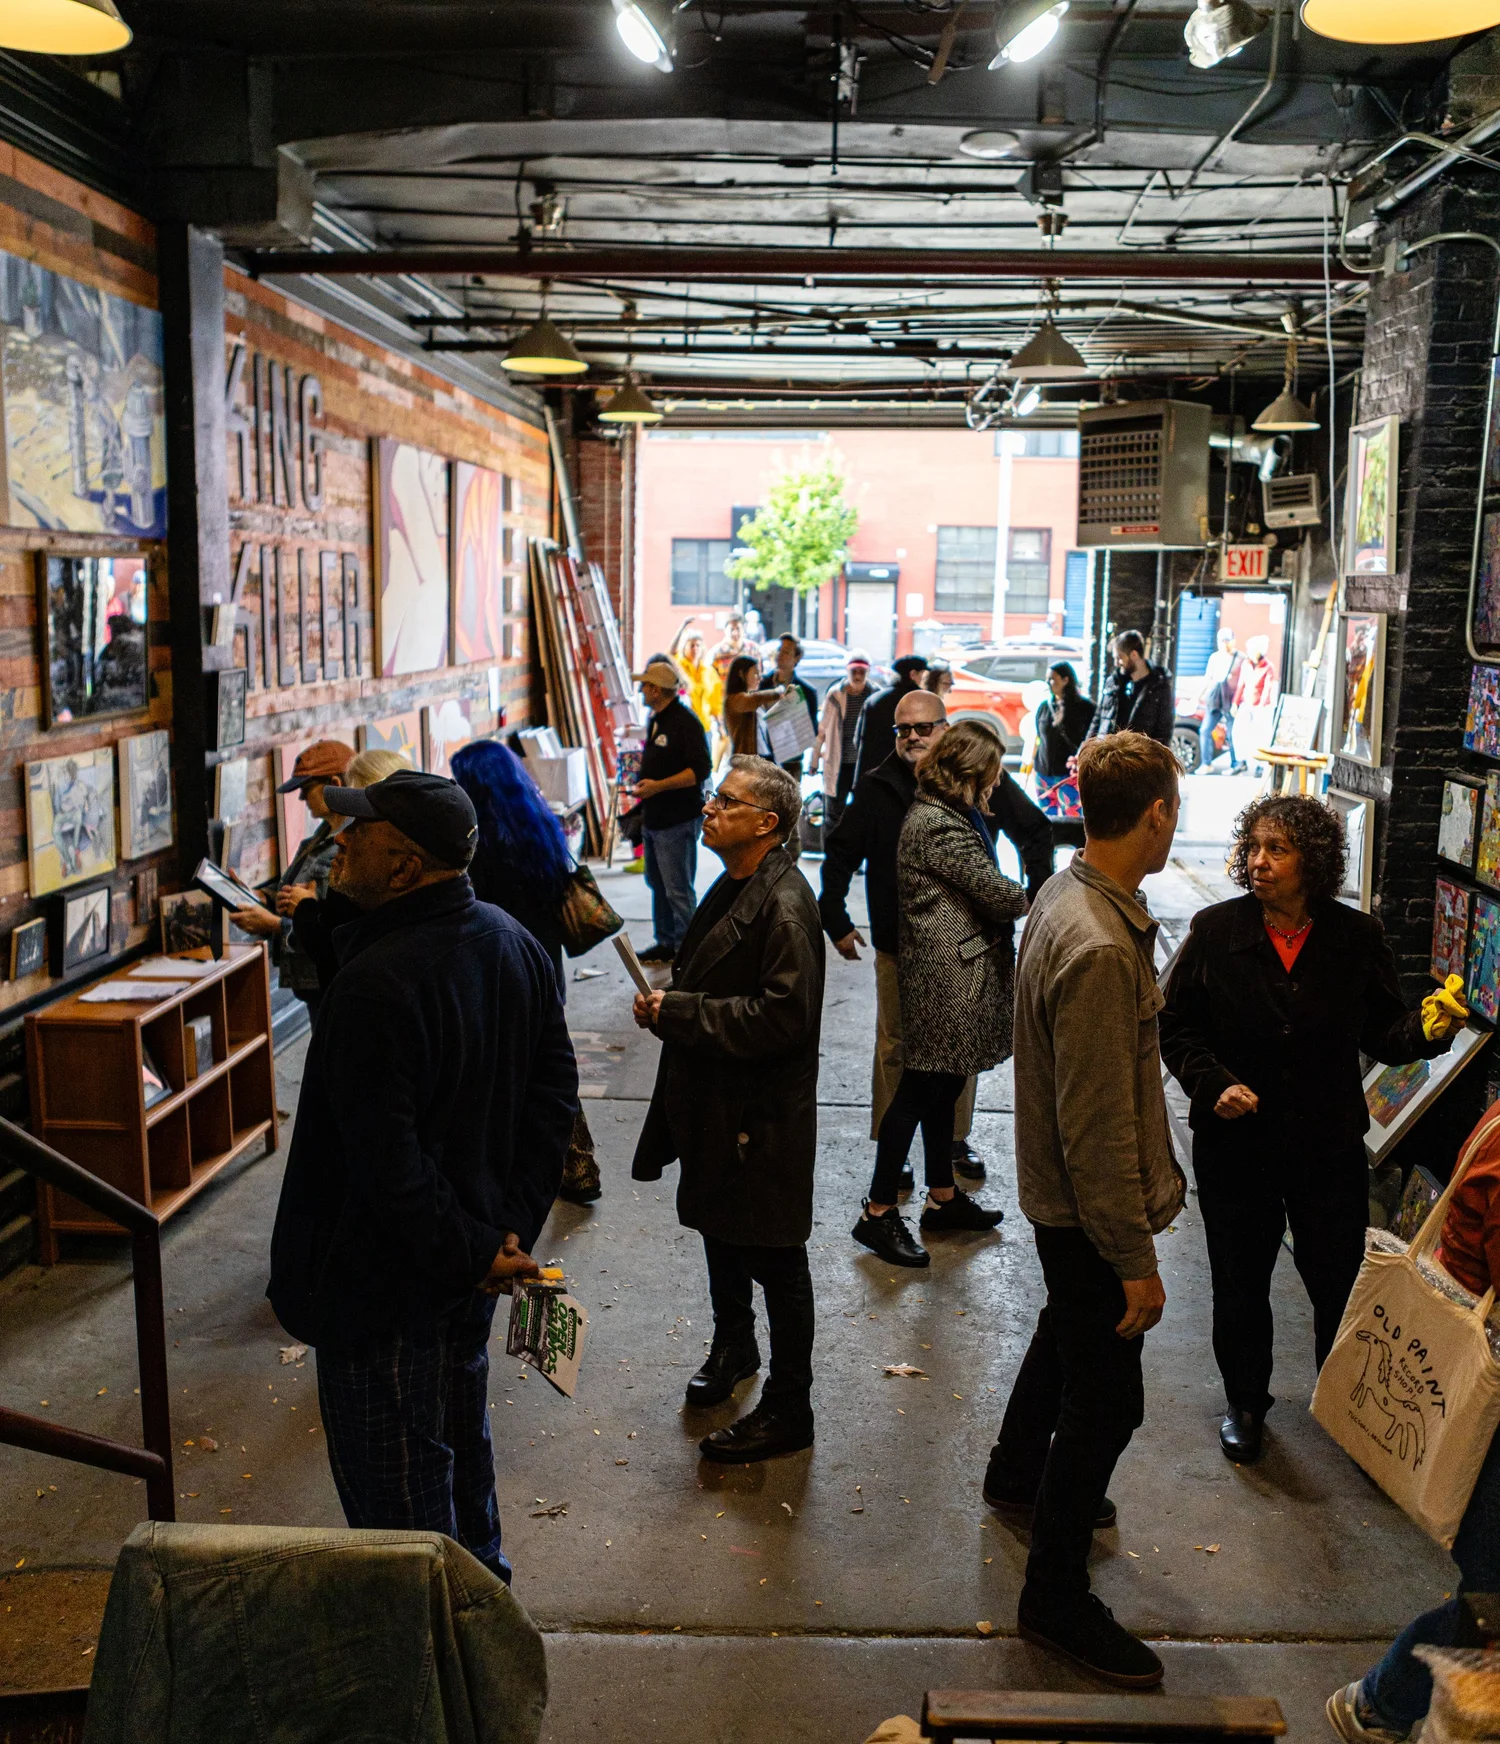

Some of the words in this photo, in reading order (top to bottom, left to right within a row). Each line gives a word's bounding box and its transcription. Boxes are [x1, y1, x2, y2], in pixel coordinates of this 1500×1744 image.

[1227, 549, 1264, 577] EXIT
[547, 1295, 559, 1374] STUDIOS
[558, 1302, 568, 1356] OPEN
[1373, 1305, 1401, 1339] OLD
[1407, 1339, 1445, 1418] PAINT
[1399, 1357, 1424, 1394] RECORD
[1394, 1370, 1418, 1400] SHOP!
